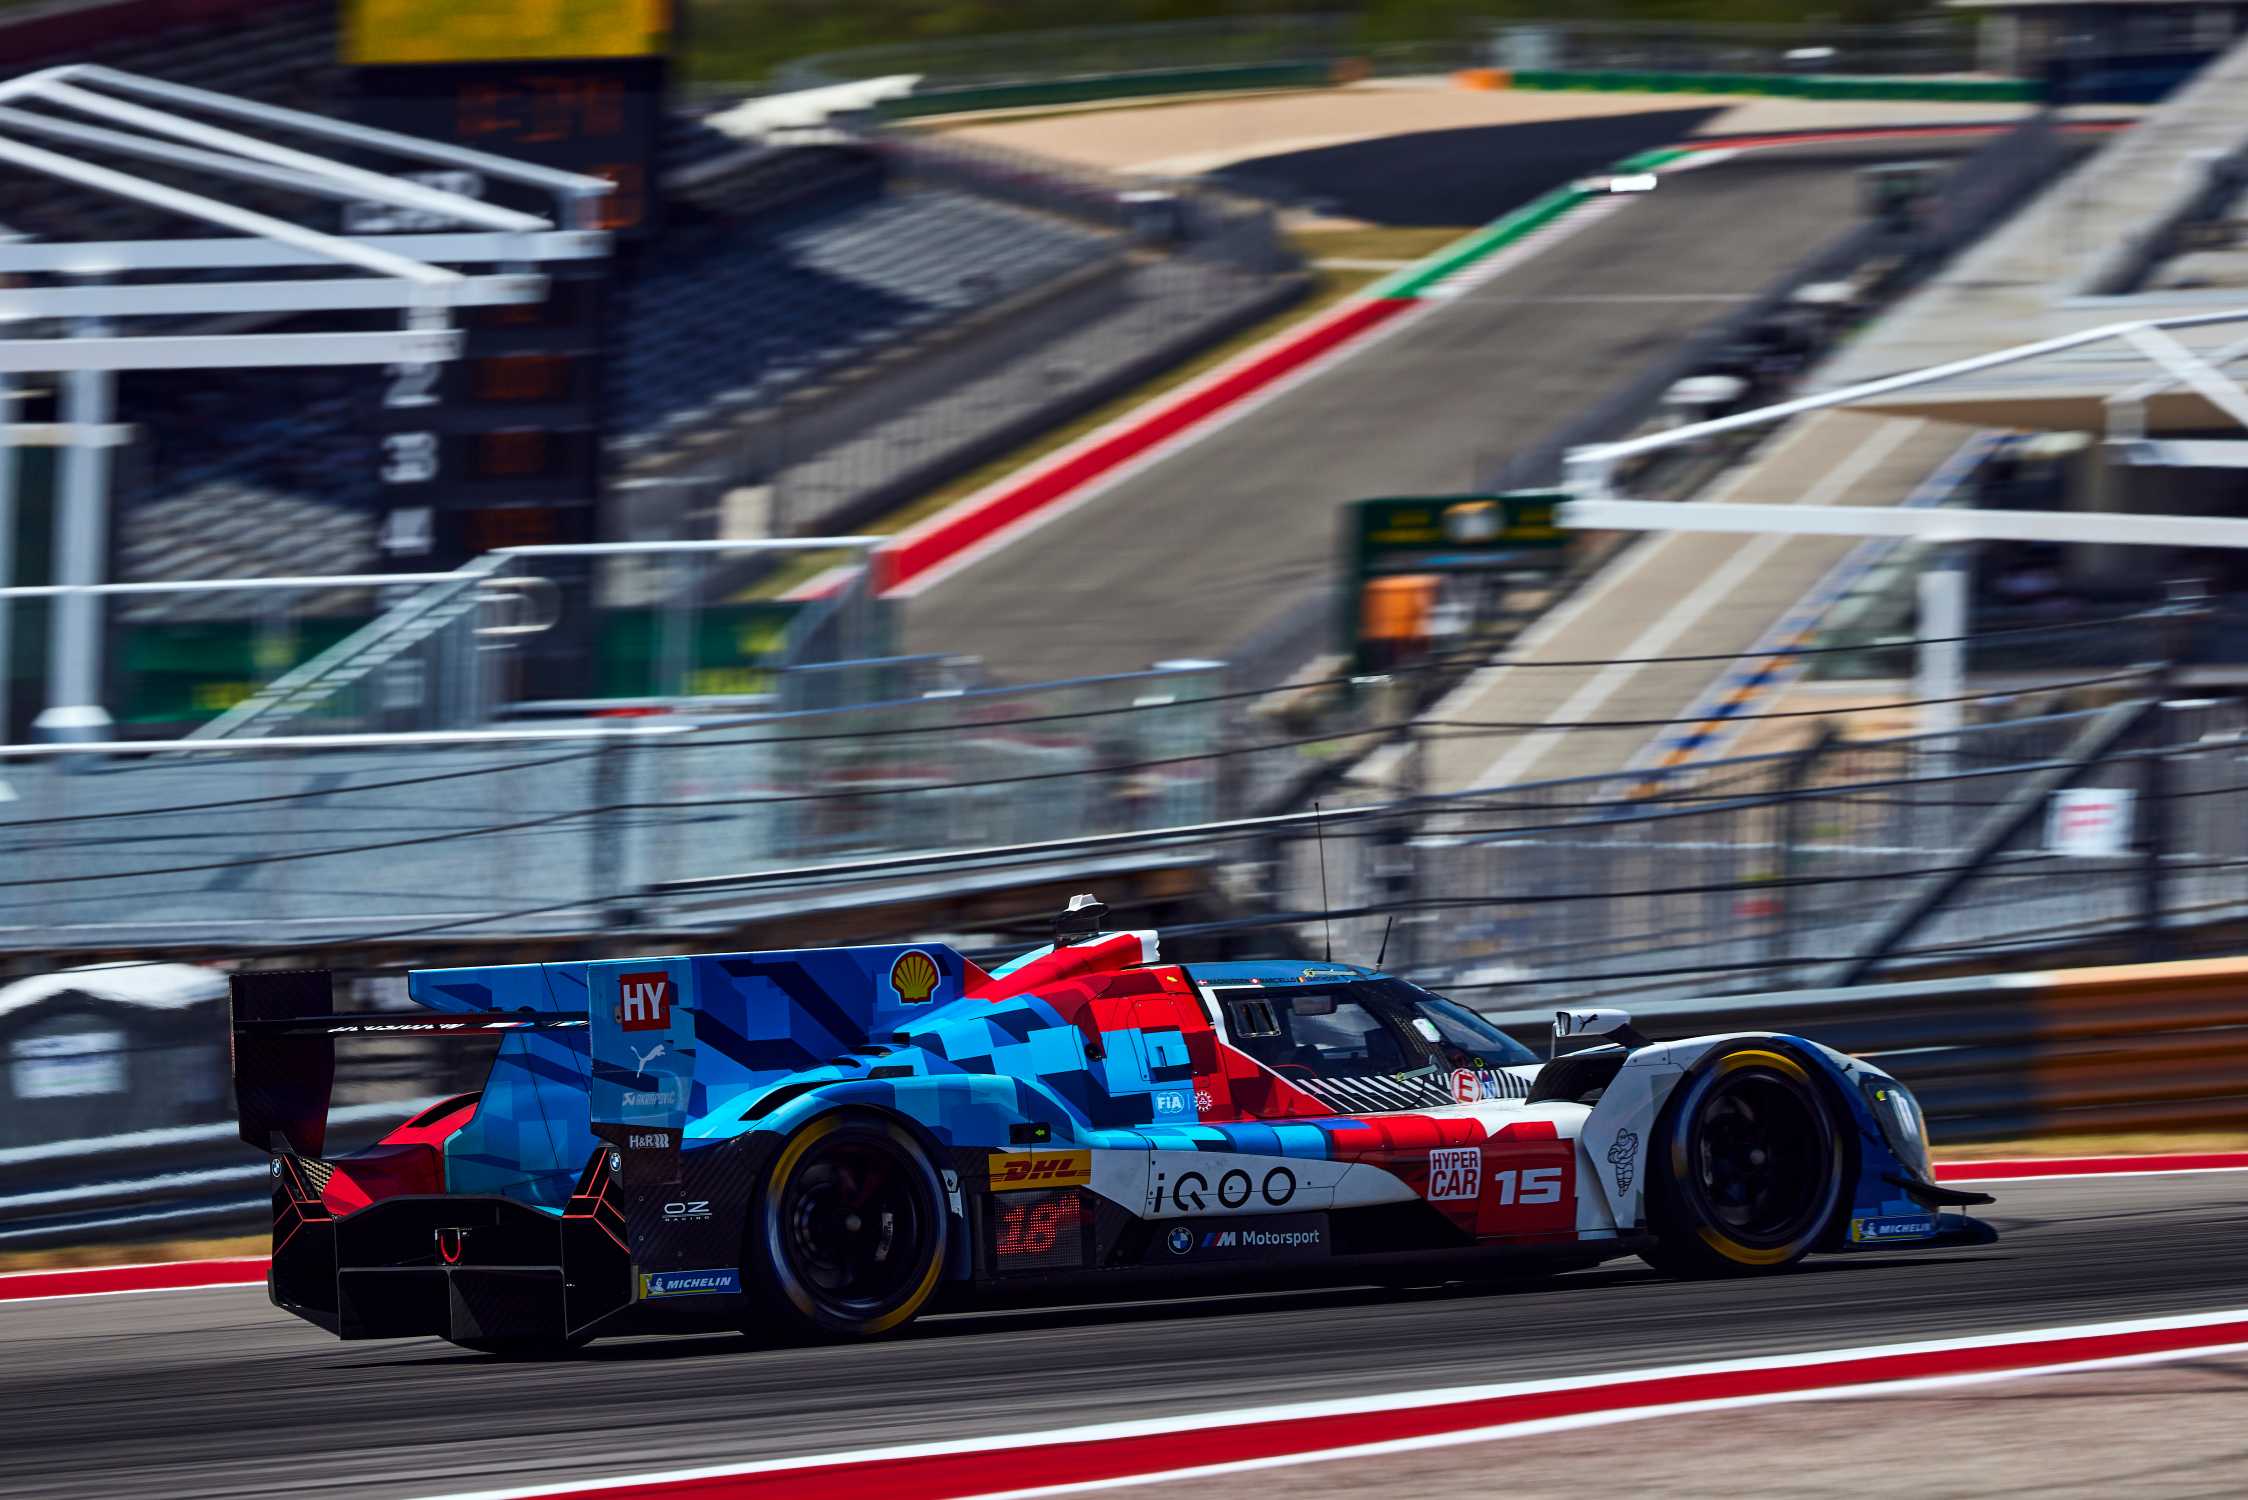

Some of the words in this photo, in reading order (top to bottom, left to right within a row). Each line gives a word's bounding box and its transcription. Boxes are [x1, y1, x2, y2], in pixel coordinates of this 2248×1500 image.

[623, 982, 666, 1021] HY
[1156, 1095, 1182, 1110] FIA
[629, 1134, 655, 1148] H&R
[1432, 1151, 1478, 1170] HYPER
[1003, 1159, 1077, 1181] DHL
[1153, 1166, 1297, 1213] iQOO
[1431, 1169, 1477, 1197] CAR
[1495, 1168, 1562, 1206] 15
[664, 1201, 710, 1214] OZ
[1879, 1223, 1931, 1233] MICHELIN
[1243, 1229, 1320, 1247] Motorsport
[667, 1276, 732, 1289] MICHELIN
